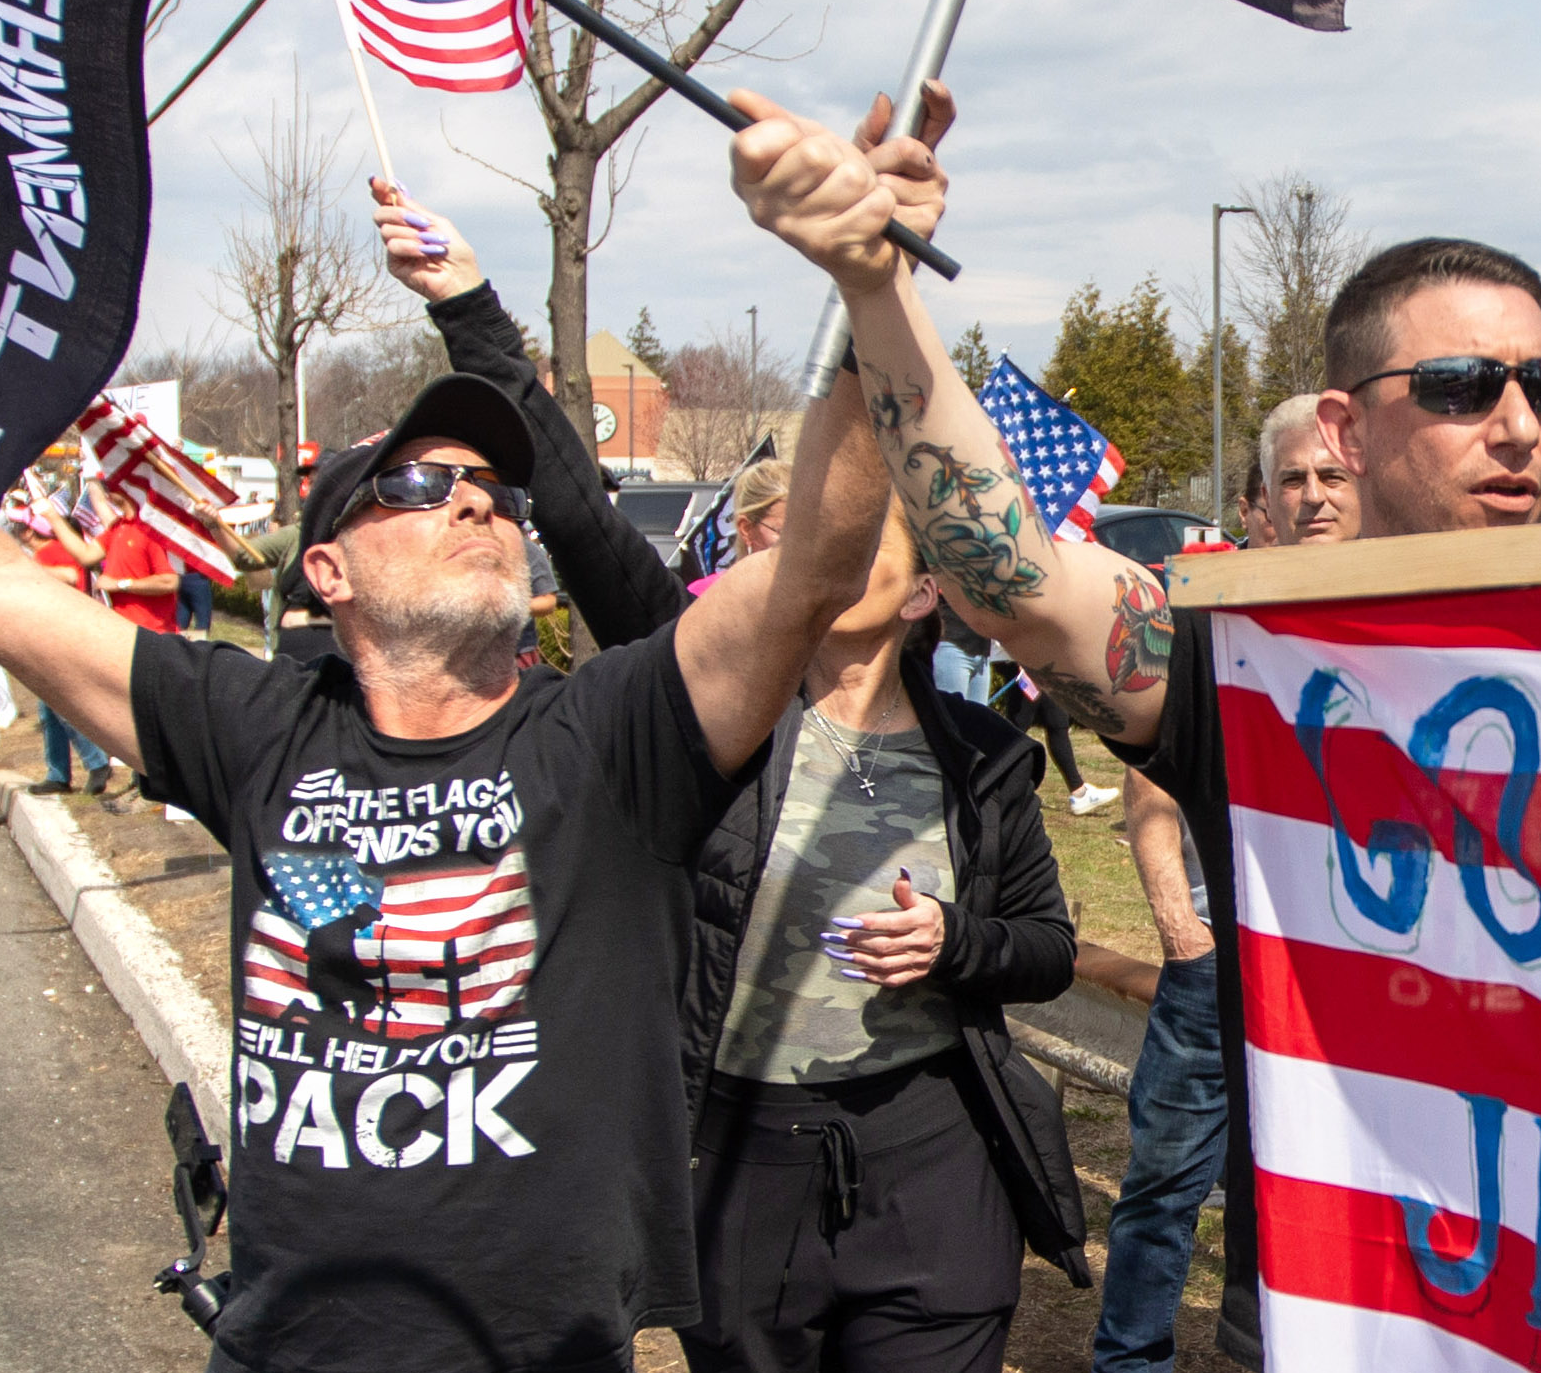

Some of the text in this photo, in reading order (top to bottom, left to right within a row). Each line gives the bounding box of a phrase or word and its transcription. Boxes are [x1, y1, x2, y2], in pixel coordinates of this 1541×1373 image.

[282, 790, 525, 865] OFFENDS YOU
[345, 778, 495, 821] THE FLAG
[257, 1025, 315, 1065] I'LL
[236, 1052, 541, 1169] PACK
